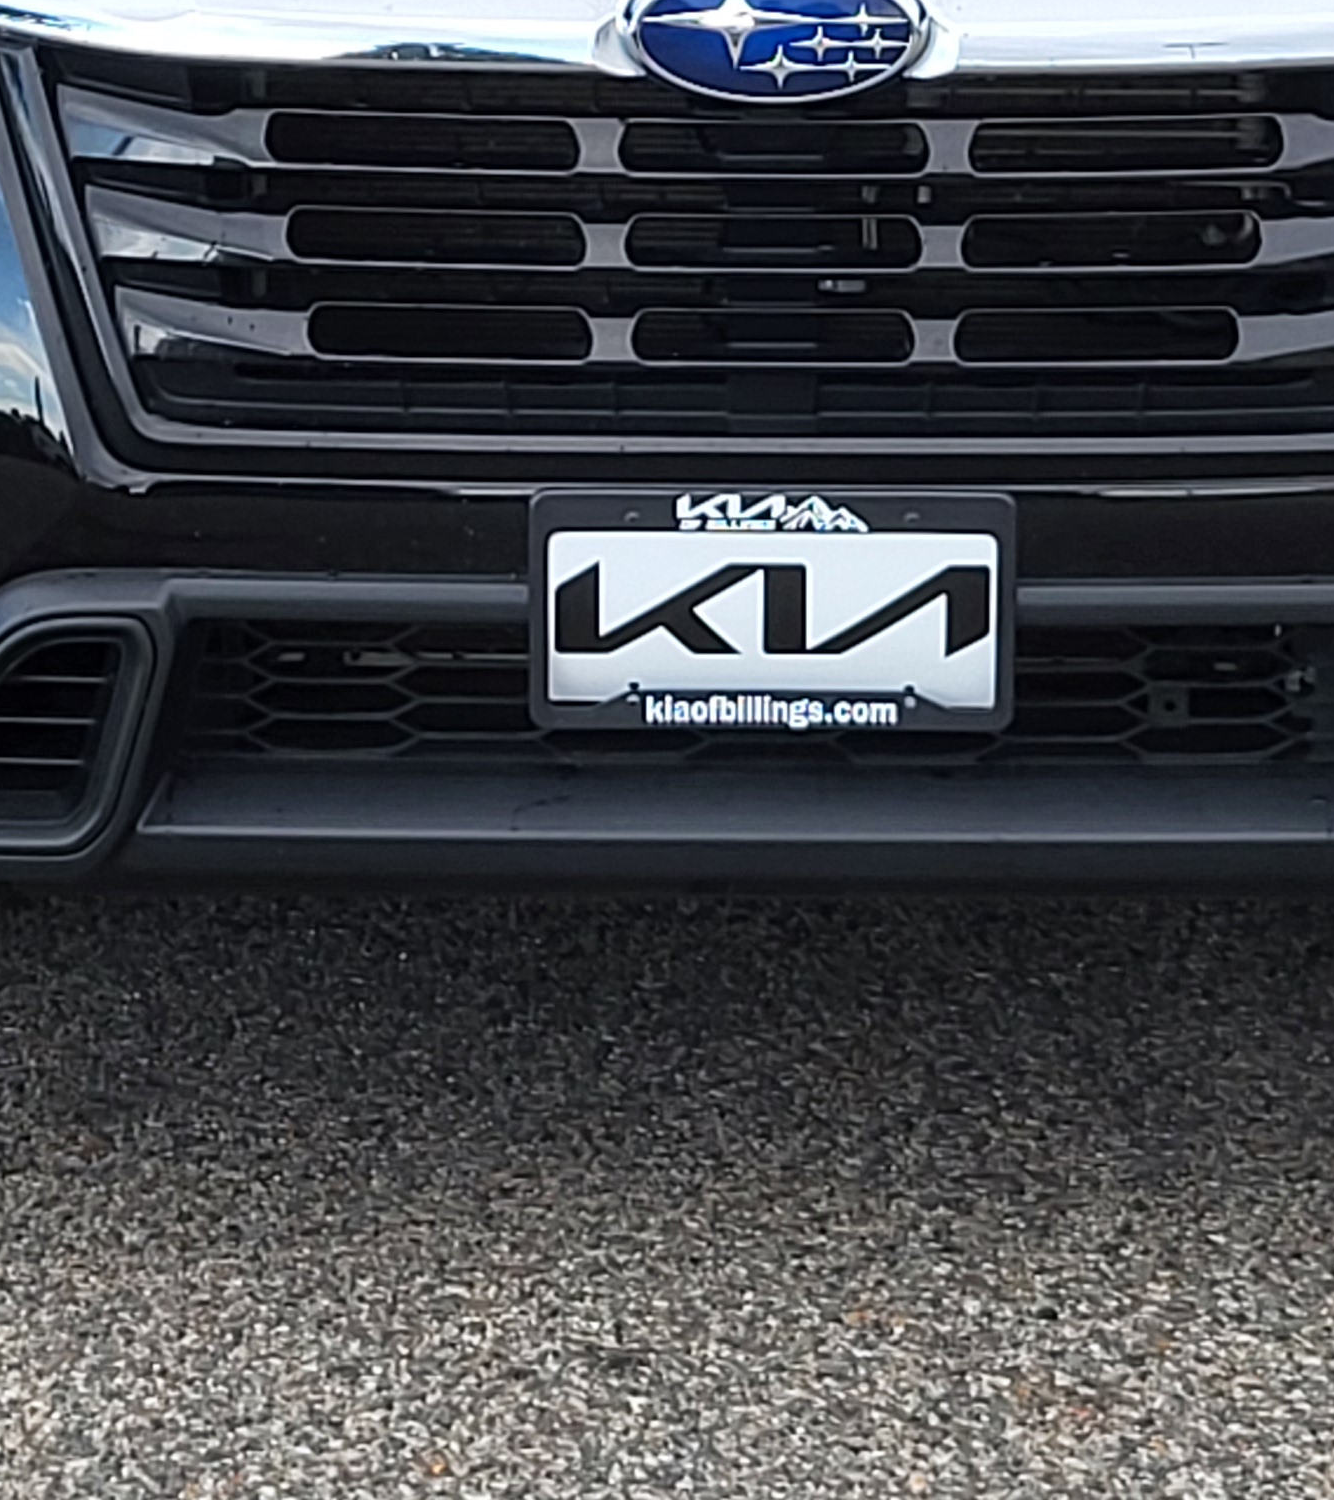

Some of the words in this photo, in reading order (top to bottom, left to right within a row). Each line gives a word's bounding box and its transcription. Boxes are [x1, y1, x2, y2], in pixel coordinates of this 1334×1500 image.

[676, 493, 786, 519] KIA
[554, 560, 991, 658] KIA
[645, 695, 899, 730] kiaofbillings.com
